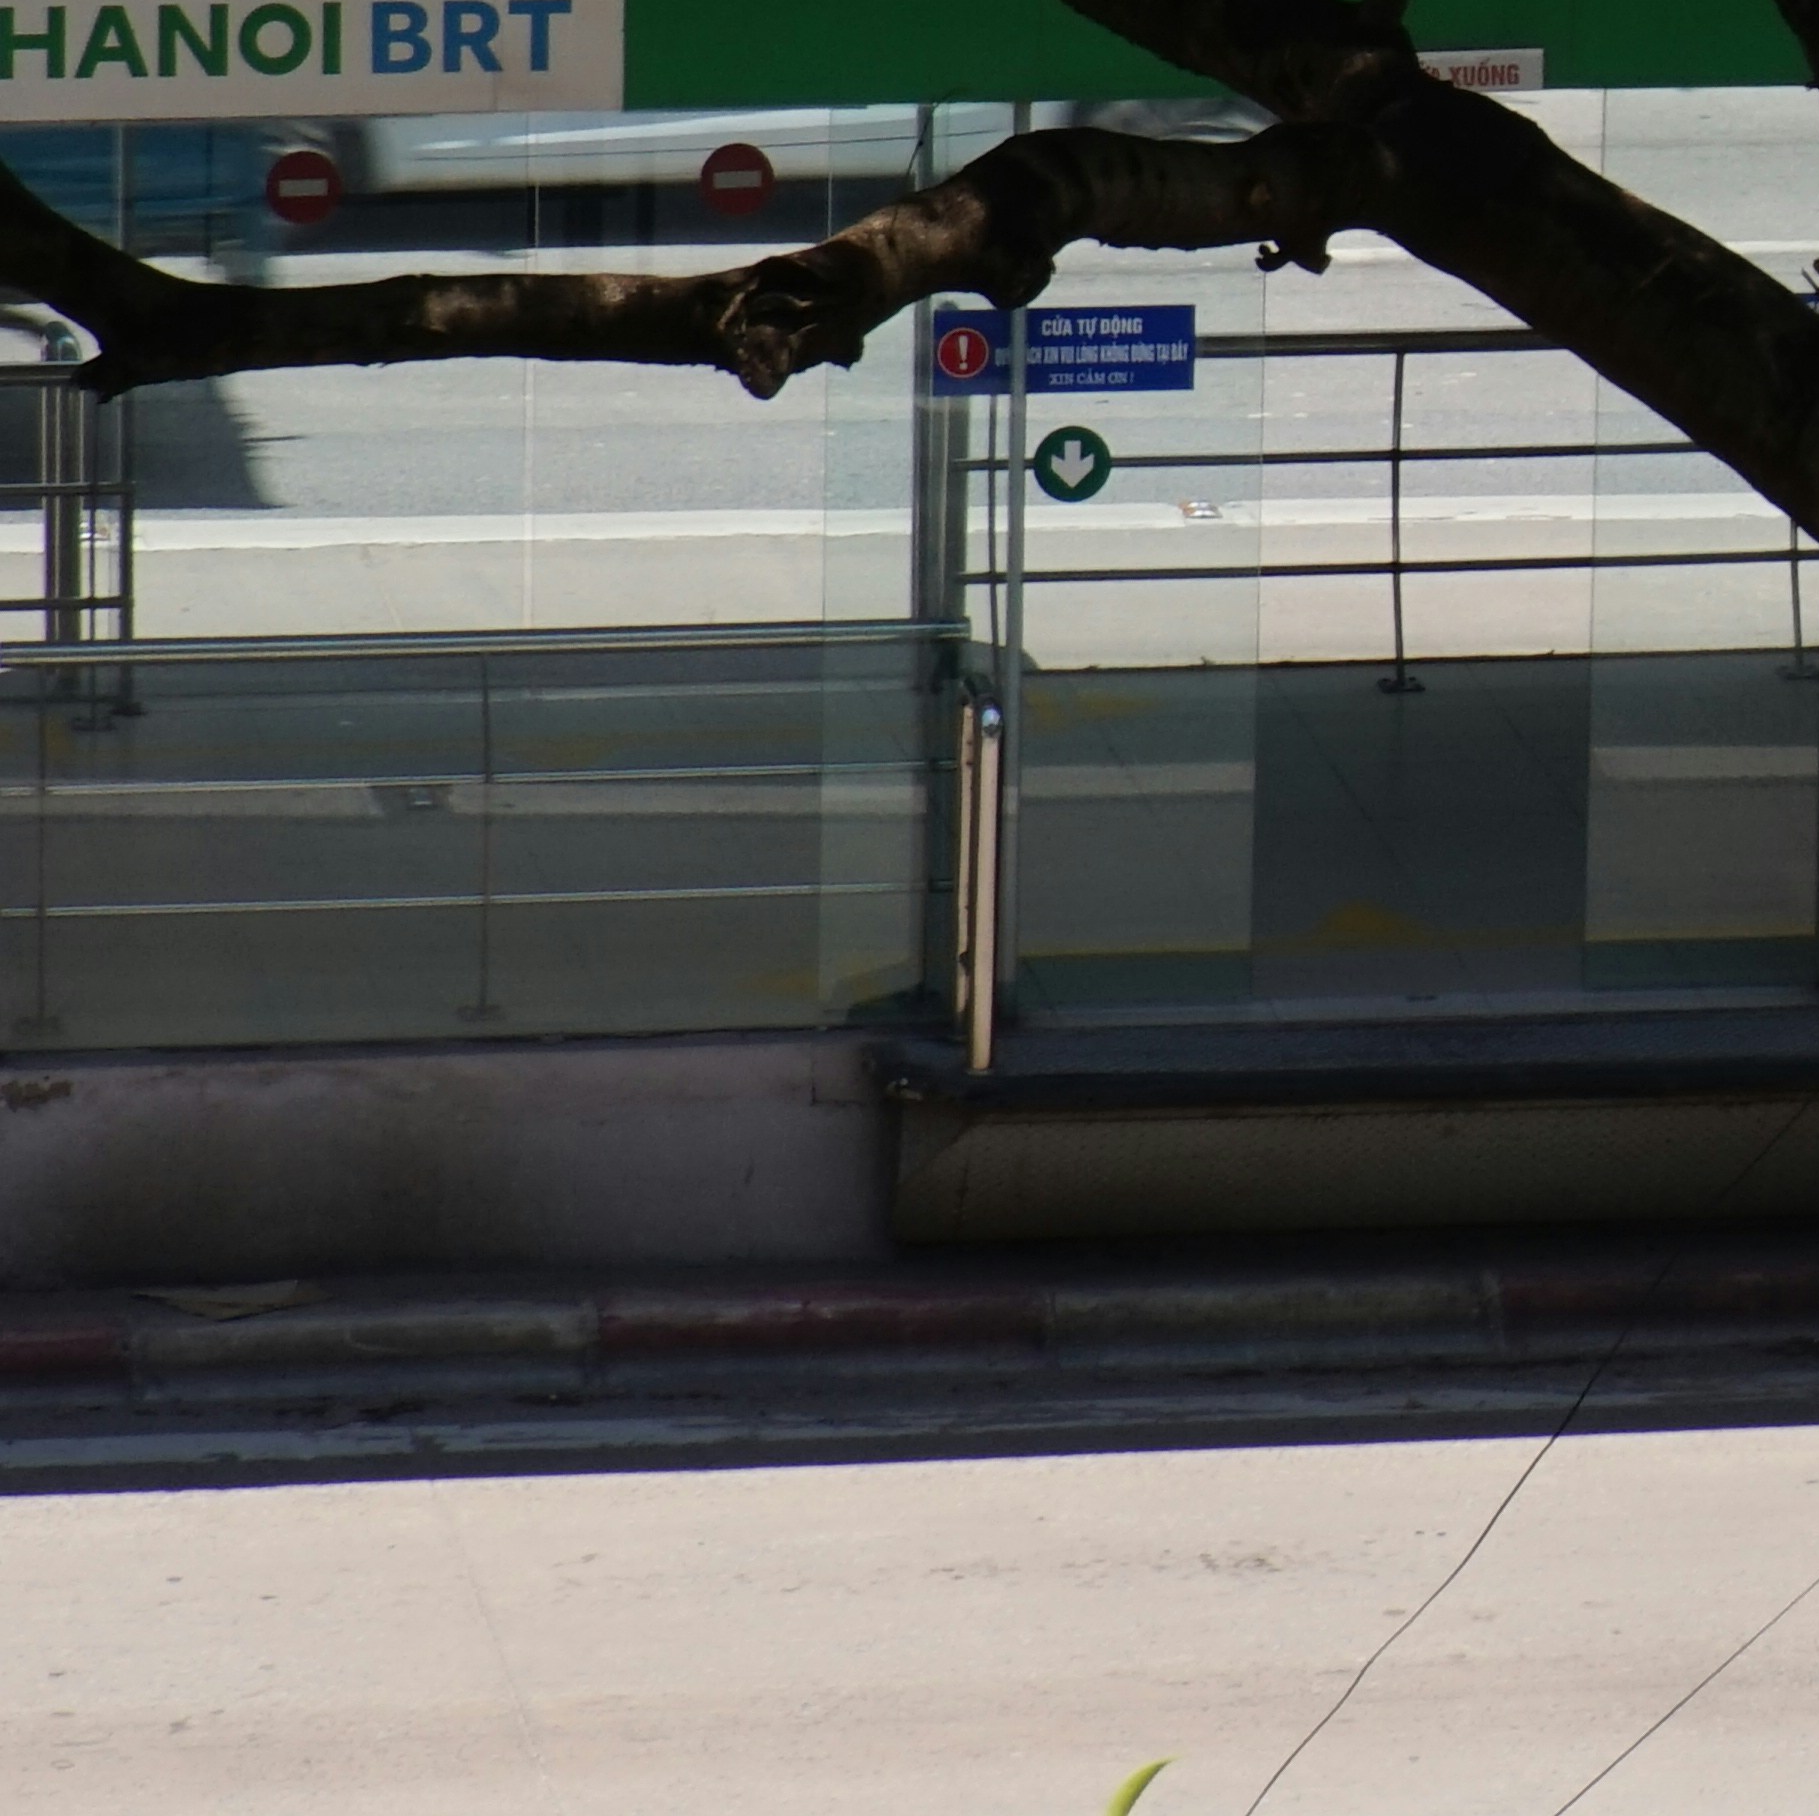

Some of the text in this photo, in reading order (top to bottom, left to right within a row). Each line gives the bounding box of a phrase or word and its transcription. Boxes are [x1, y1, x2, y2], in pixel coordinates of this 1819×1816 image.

[0, 1, 342, 80] HANOI
[1449, 57, 1520, 86] XUỐNG
[1041, 314, 1143, 340] CỬA TỰ ĐỘNG
[1049, 372, 1074, 386] XIN
